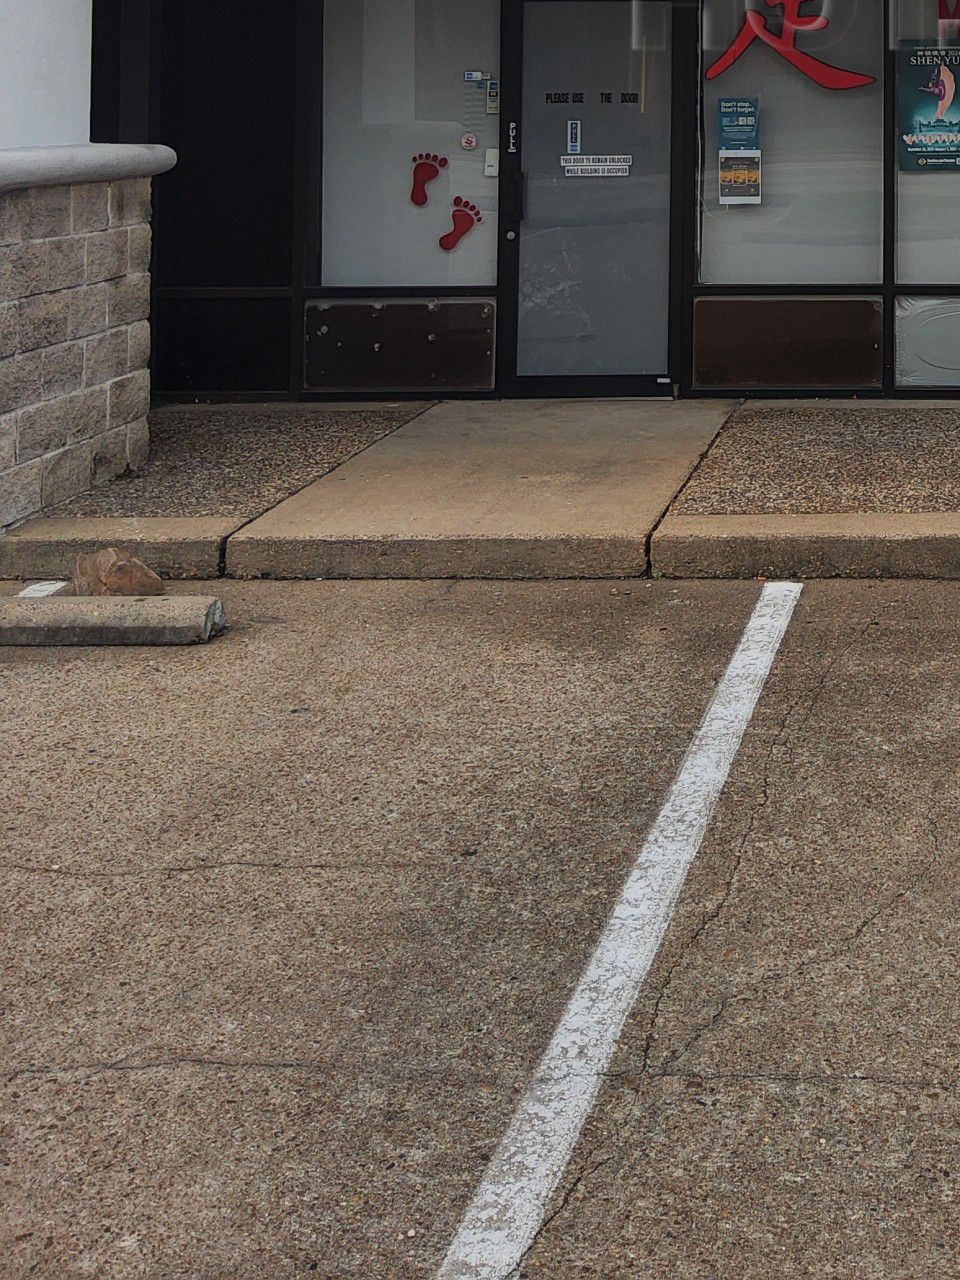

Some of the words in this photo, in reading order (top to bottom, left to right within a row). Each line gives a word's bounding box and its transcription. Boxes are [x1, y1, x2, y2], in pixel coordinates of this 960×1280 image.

[910, 56, 941, 65] SHEN
[545, 92, 570, 104] PLEASE
[572, 92, 584, 104] USE
[600, 92, 613, 104] THE
[620, 92, 639, 104] DOOR
